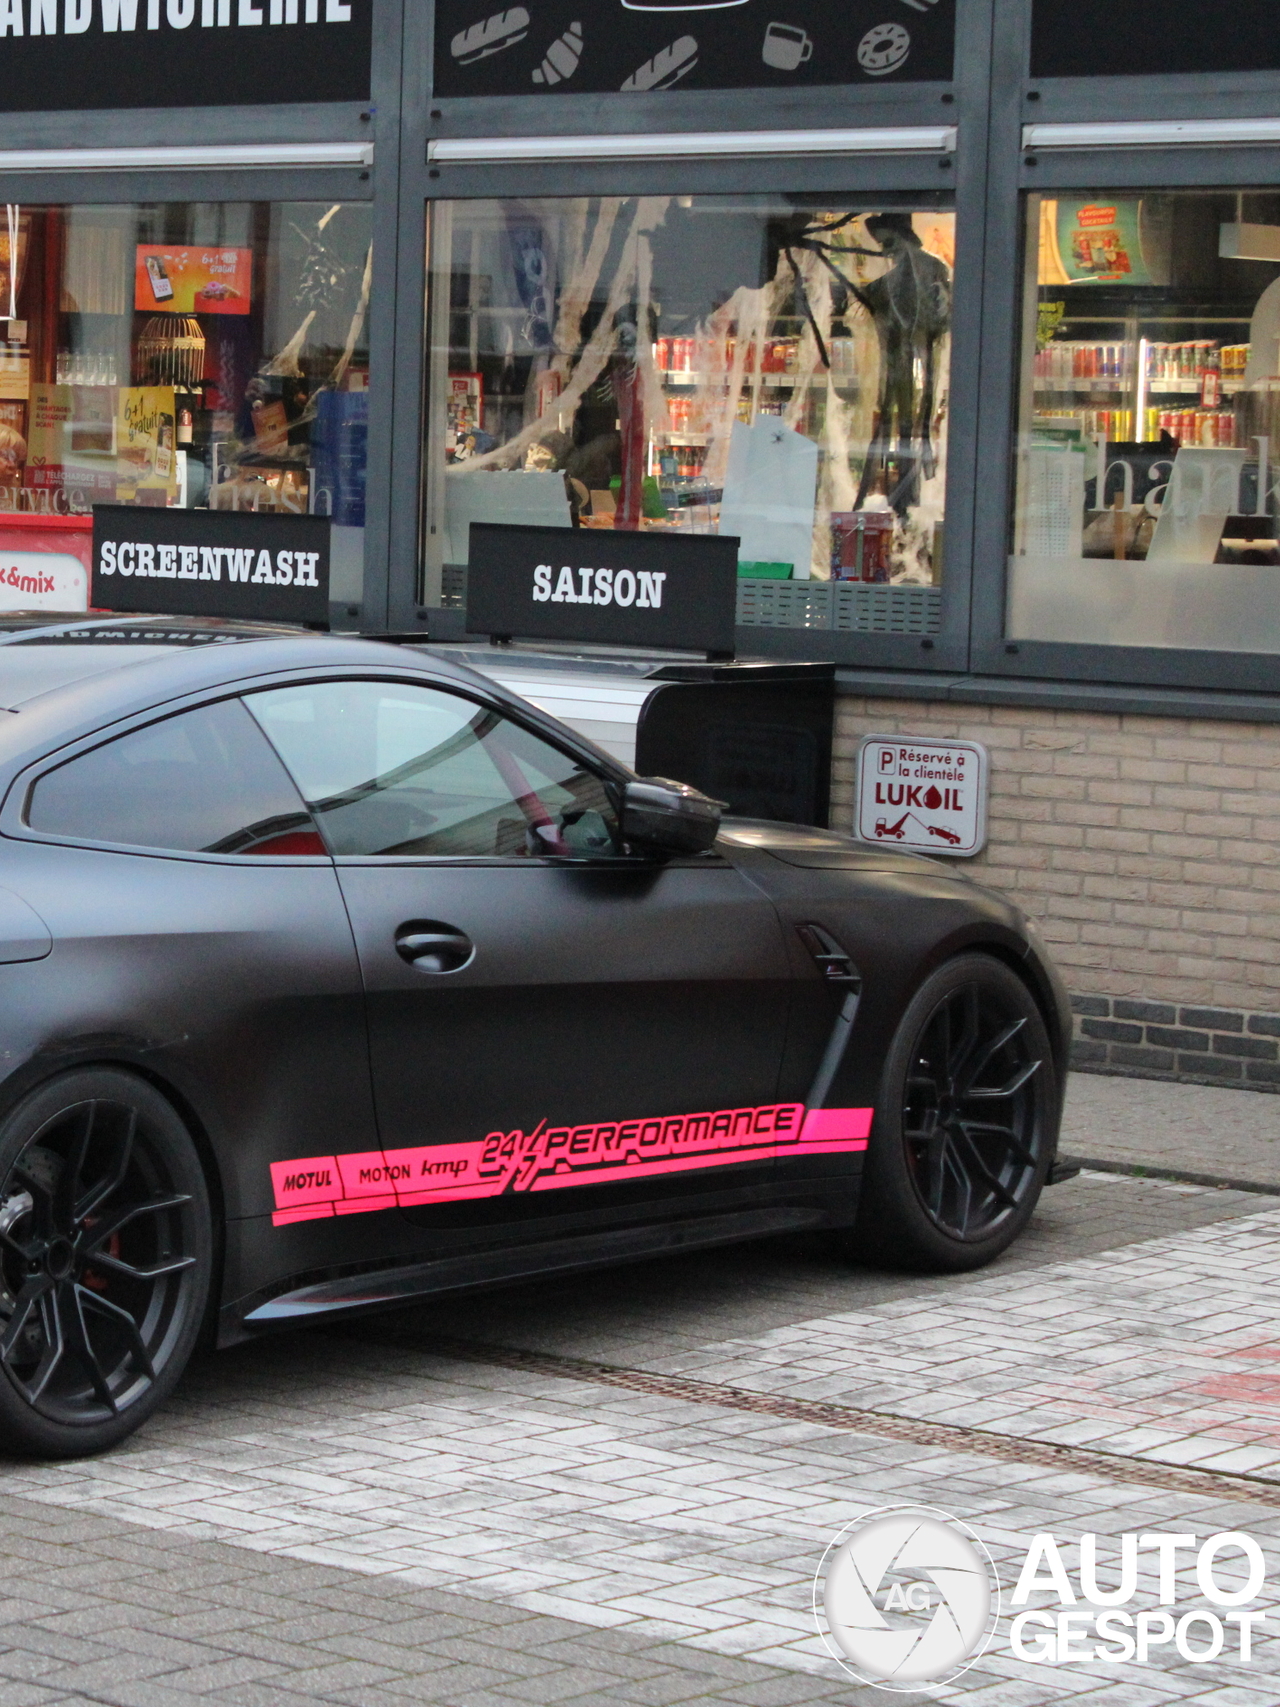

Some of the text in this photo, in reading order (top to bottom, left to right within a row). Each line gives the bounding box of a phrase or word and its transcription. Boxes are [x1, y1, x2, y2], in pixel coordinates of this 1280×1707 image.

[100, 541, 320, 588] SCREENWASH
[532, 564, 667, 609] SAISON
[881, 751, 893, 771] P
[899, 748, 965, 766] Réservé à
[898, 763, 965, 782] la clientèle
[283, 1170, 332, 1191] MOTUL
[359, 1165, 410, 1184] MOTON
